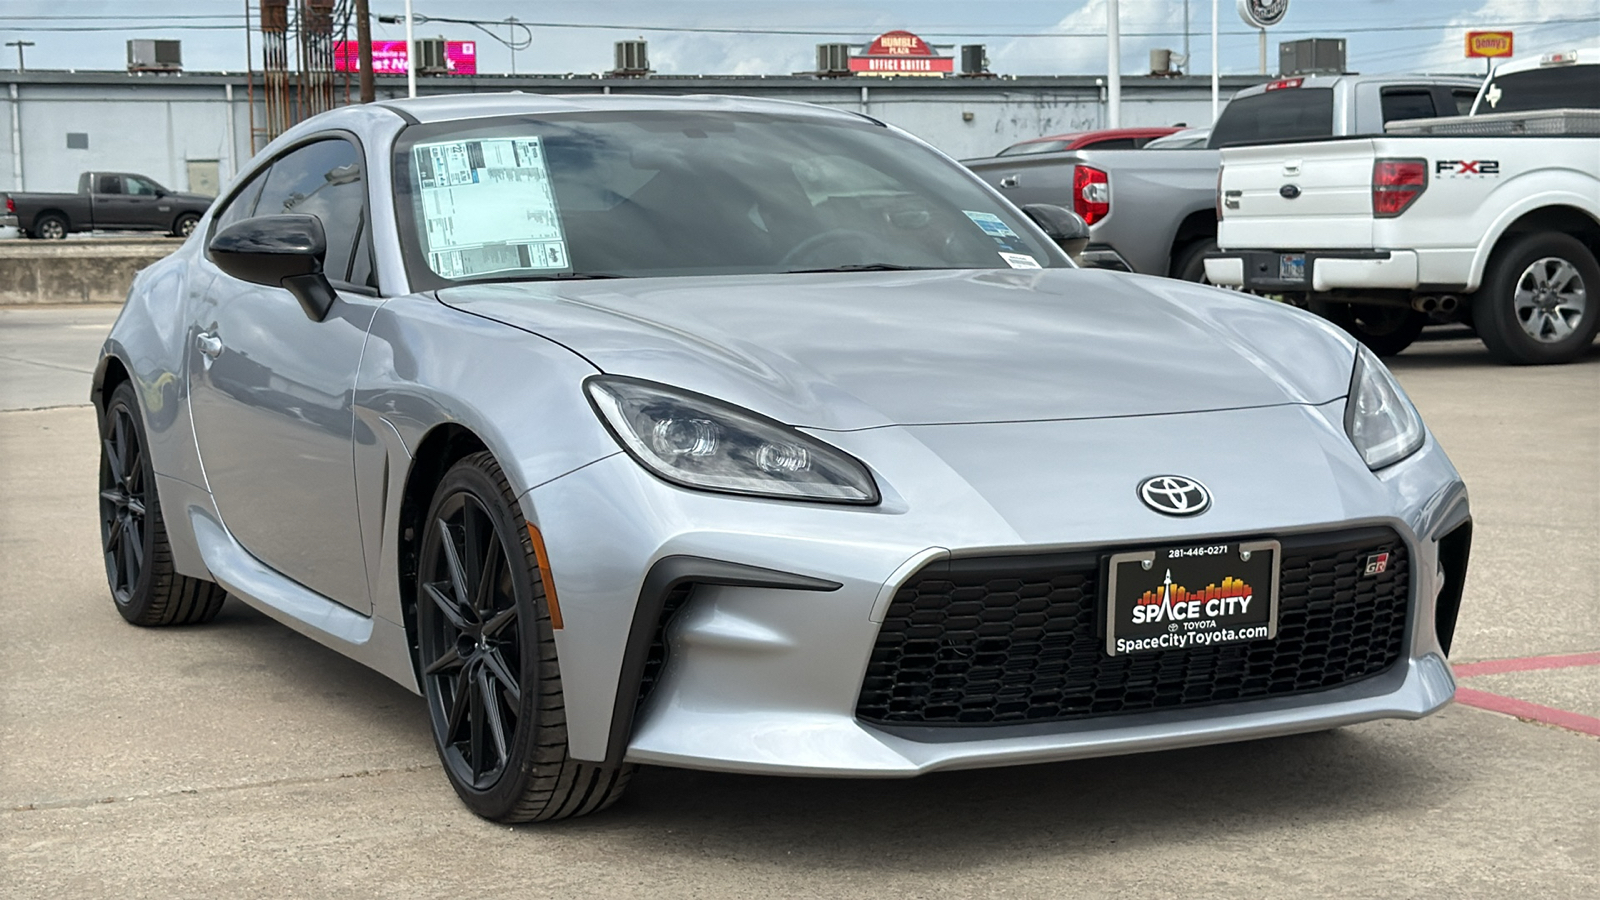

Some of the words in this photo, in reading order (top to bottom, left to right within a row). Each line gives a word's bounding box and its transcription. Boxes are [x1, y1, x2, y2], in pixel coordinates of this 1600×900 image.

[881, 37, 917, 48] HUMBLE
[869, 59, 898, 71] OFFICE
[900, 59, 931, 71] SUITES
[1435, 160, 1500, 174] FX2
[1168, 545, 1228, 558] 281-446-0271
[1366, 561, 1386, 574] GR
[1131, 594, 1202, 624] SPACE
[1205, 595, 1253, 617] CITY
[1183, 620, 1217, 631] TOYOTA
[1116, 626, 1268, 653] SpaceCityToyota.com
